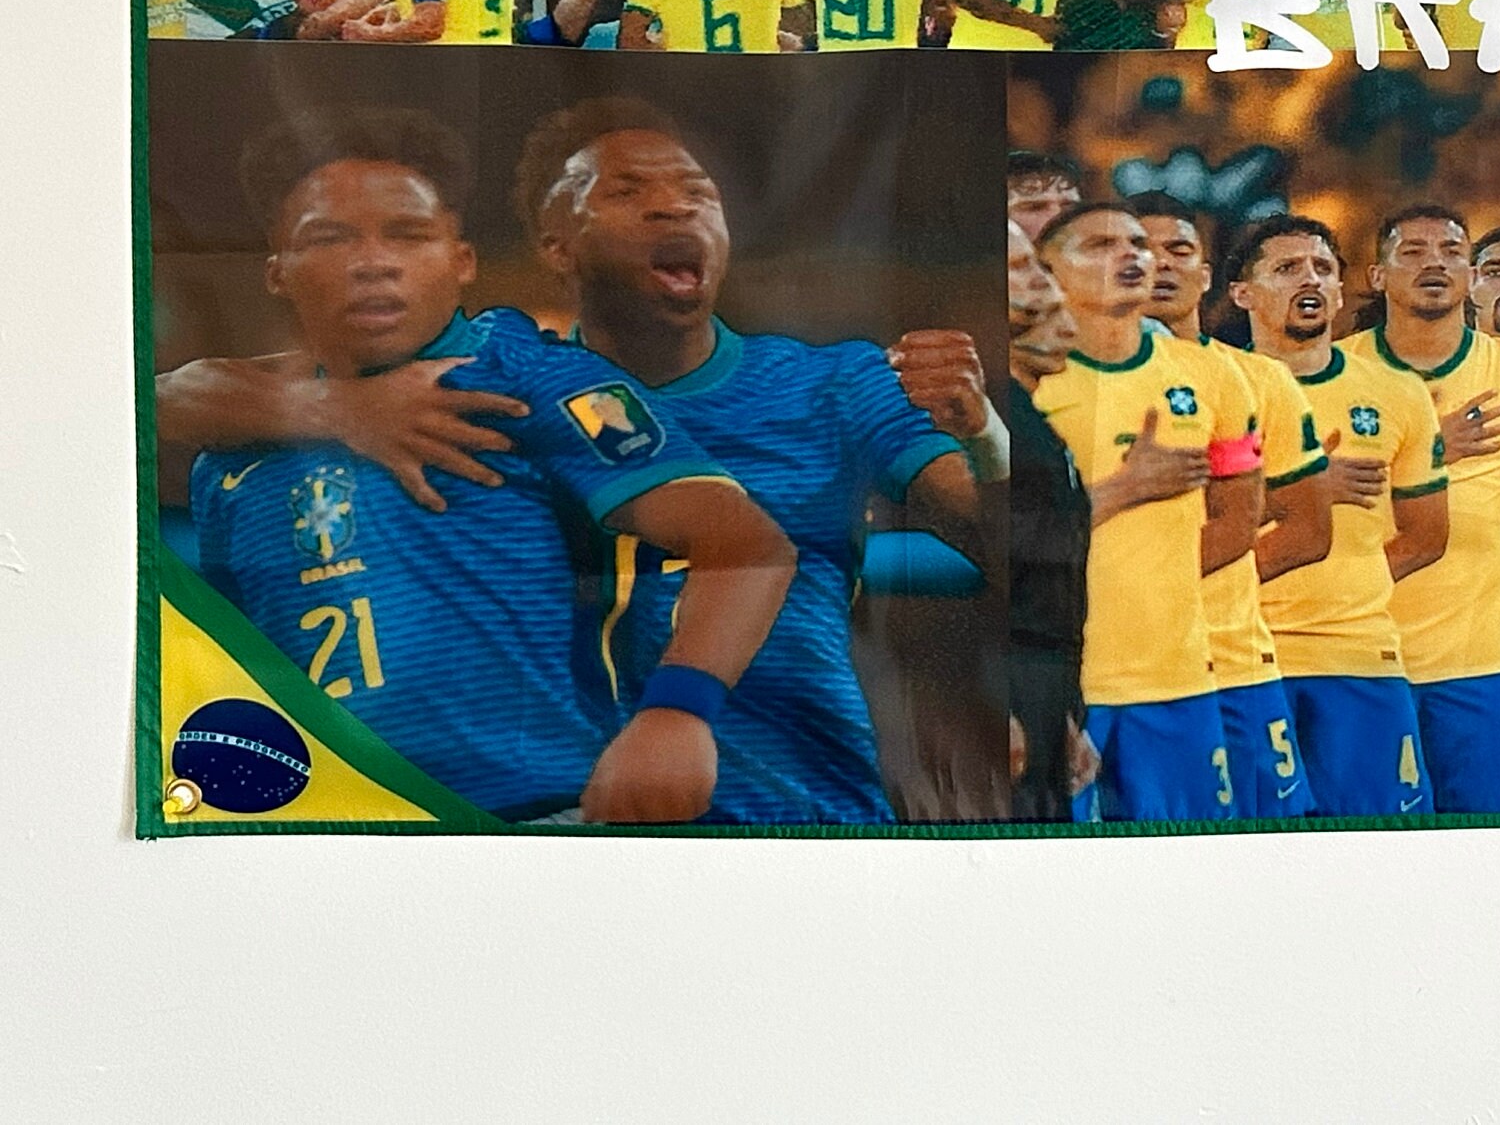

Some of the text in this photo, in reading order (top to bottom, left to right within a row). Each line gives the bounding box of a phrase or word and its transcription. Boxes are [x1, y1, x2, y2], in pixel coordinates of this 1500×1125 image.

[300, 596, 385, 699] 21
[1211, 747, 1234, 806] 3
[1267, 718, 1296, 778] 5
